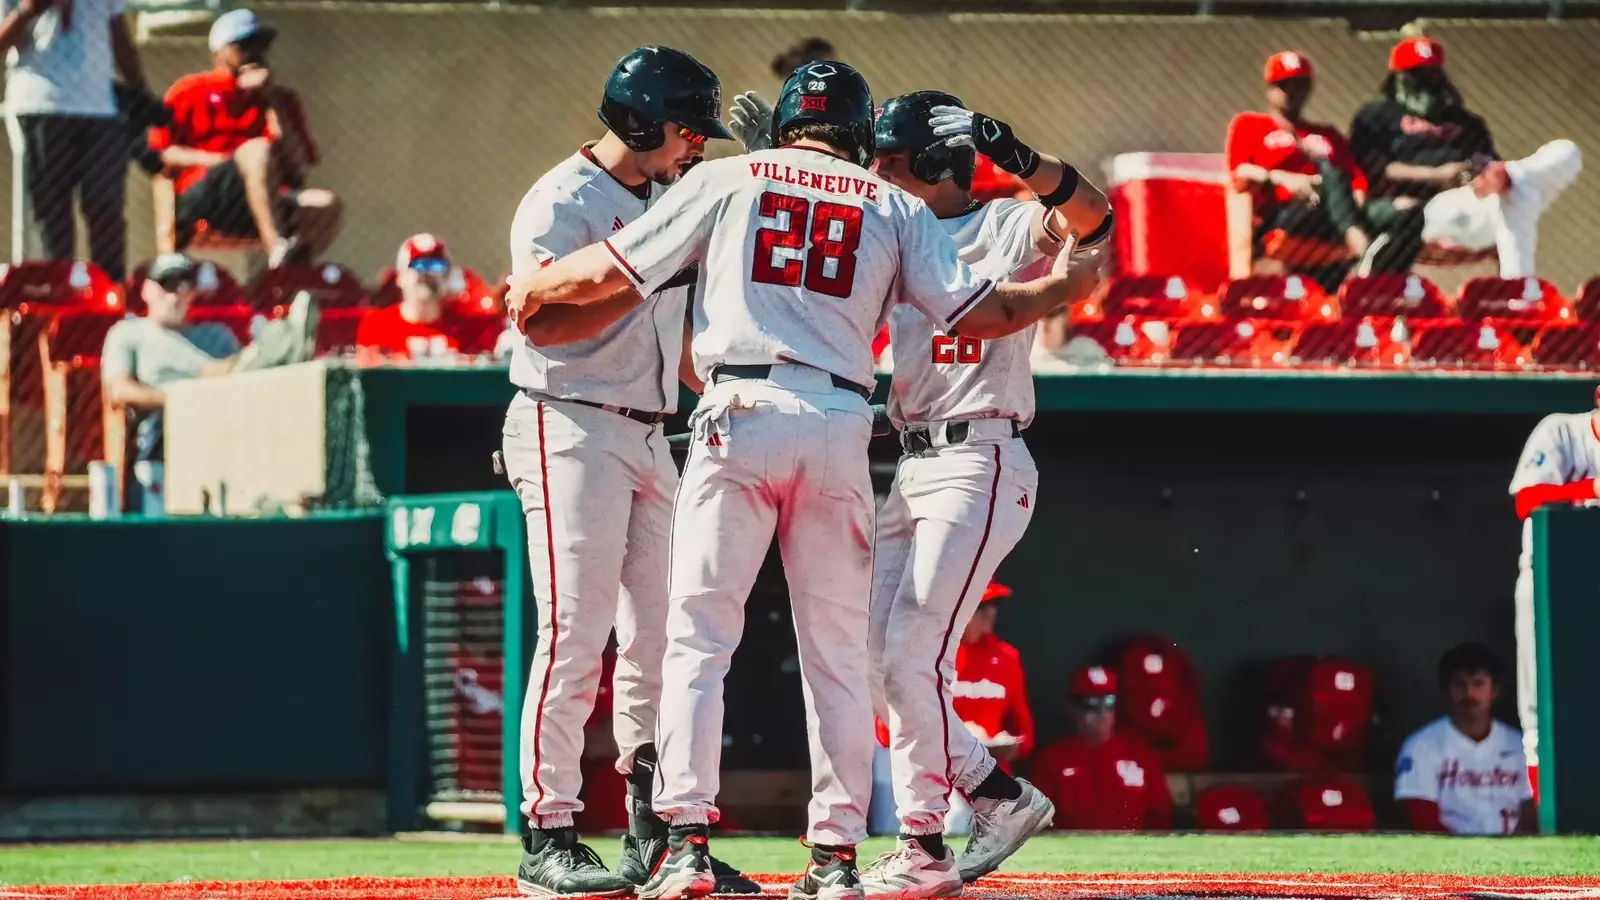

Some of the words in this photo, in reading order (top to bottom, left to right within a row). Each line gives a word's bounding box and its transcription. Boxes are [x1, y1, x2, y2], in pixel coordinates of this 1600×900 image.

[809, 80, 827, 92] 28
[749, 162, 878, 201] VILLENEUVE
[751, 190, 864, 299] 28
